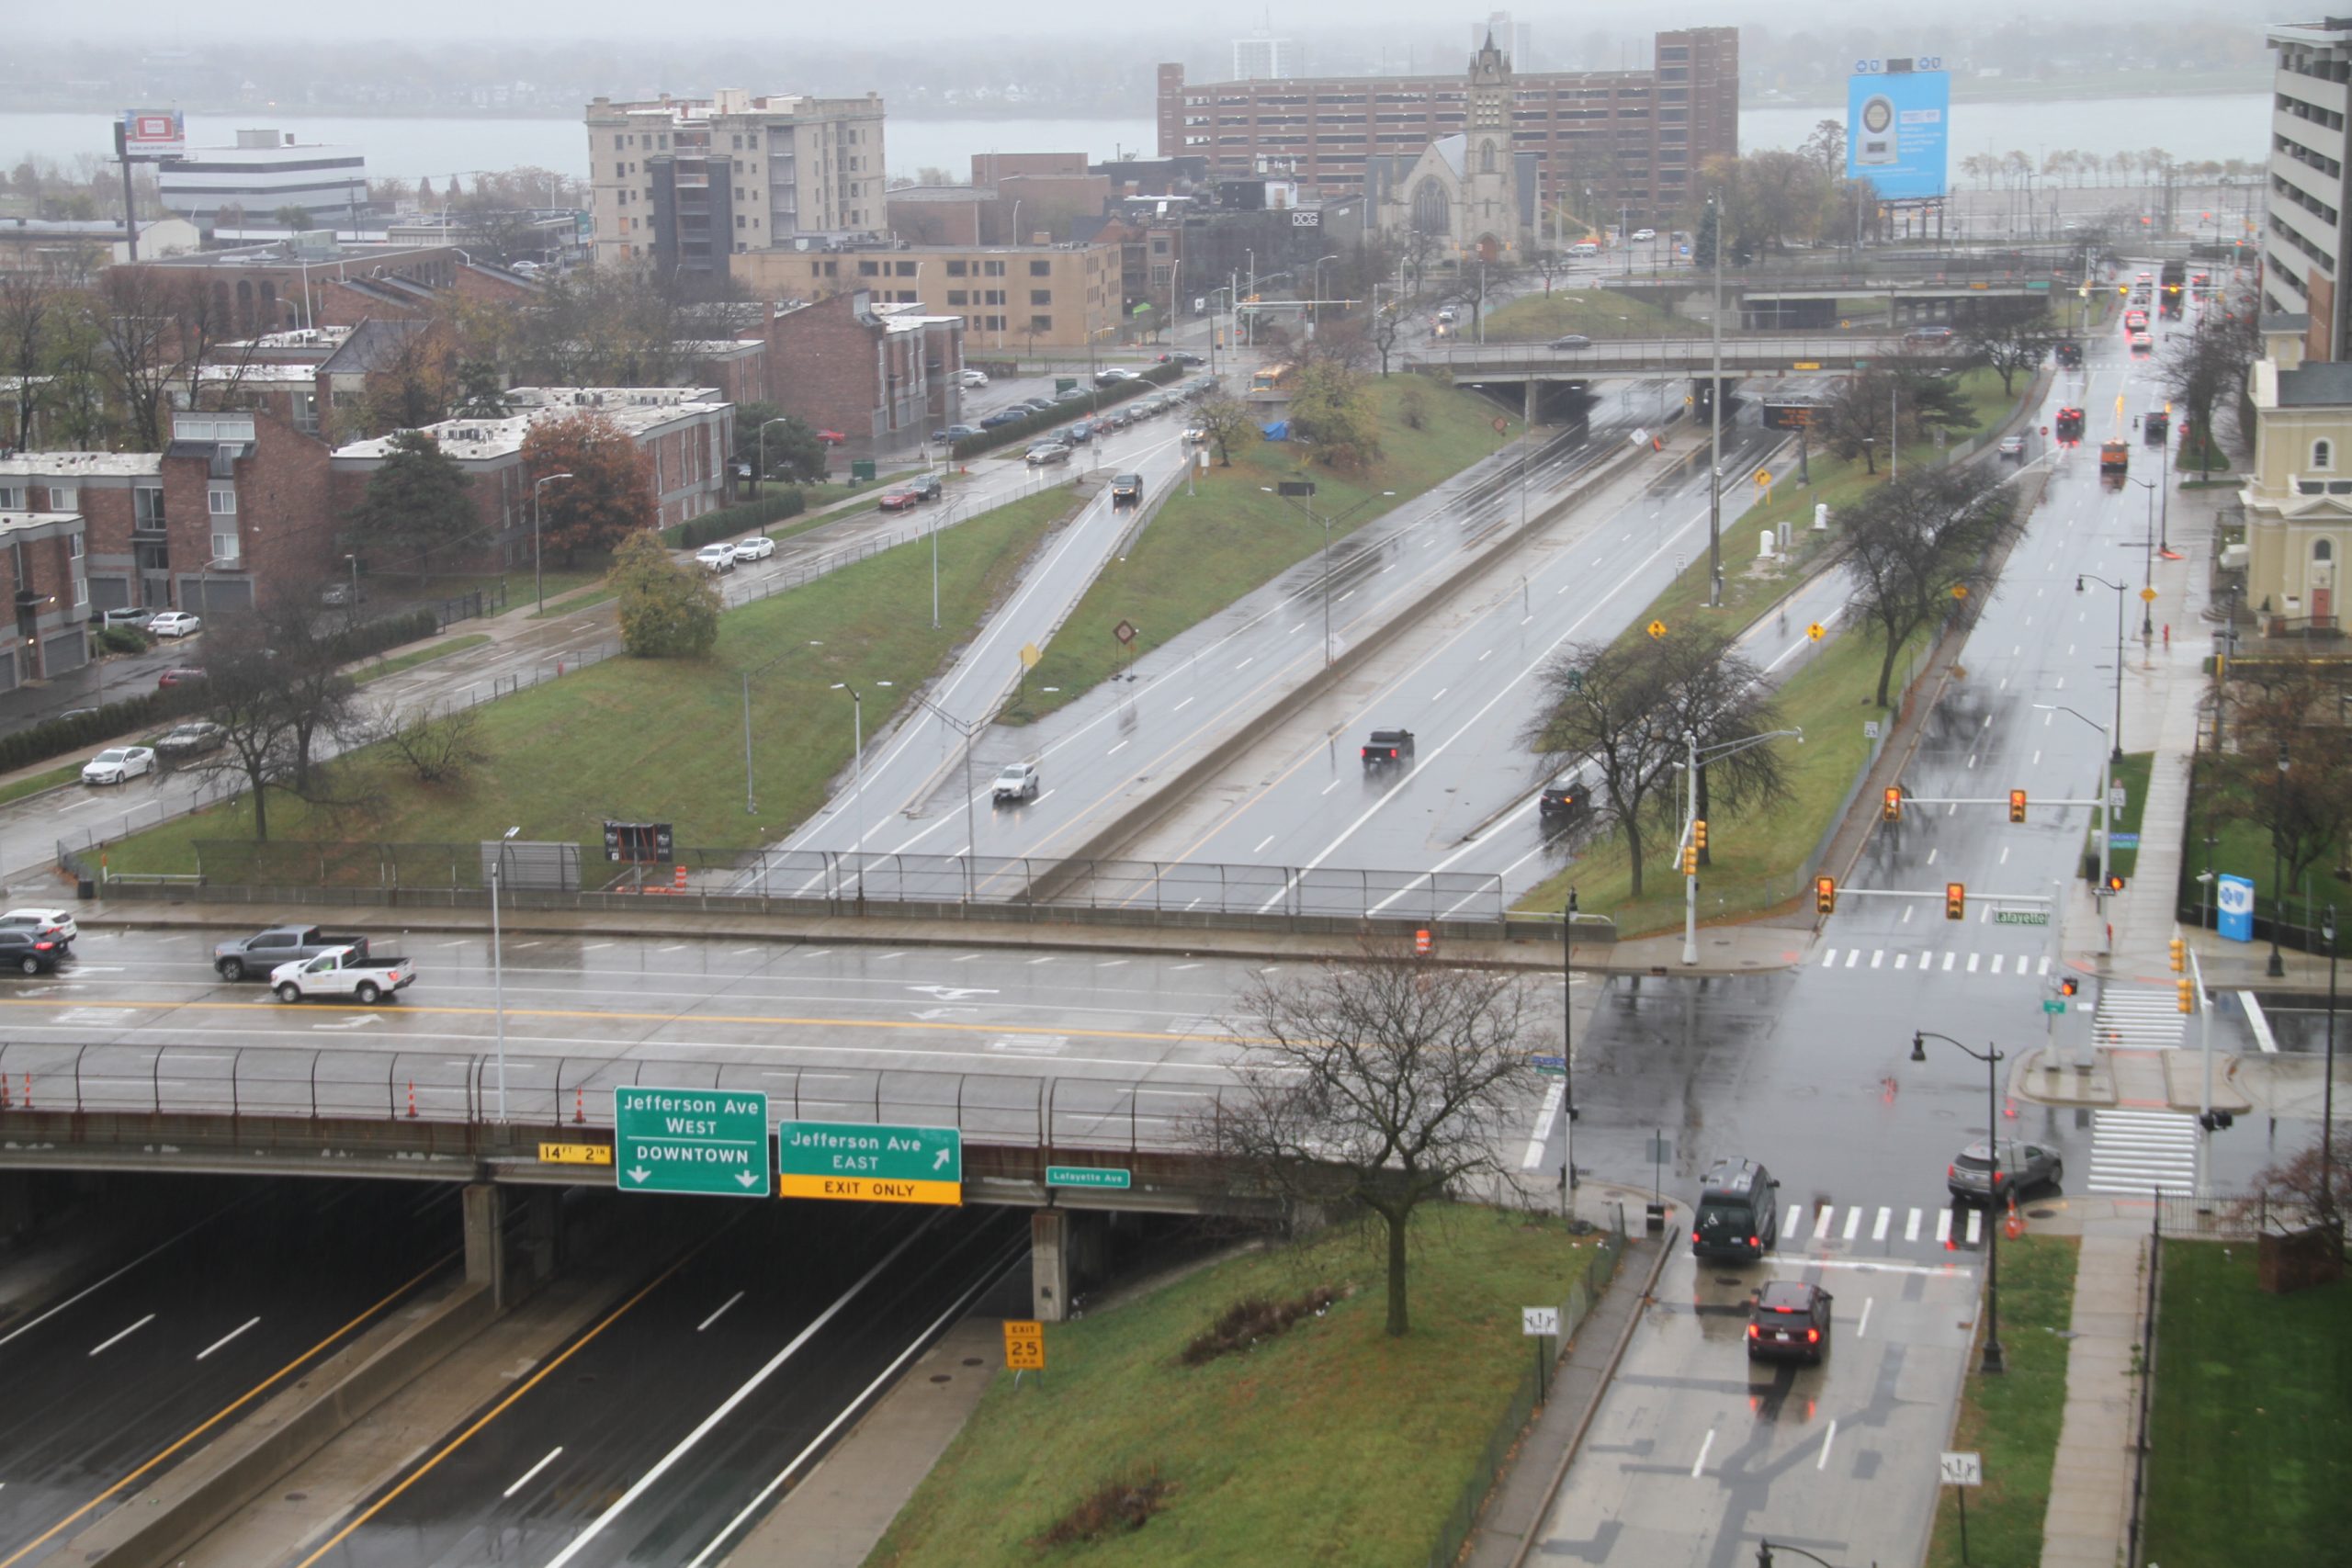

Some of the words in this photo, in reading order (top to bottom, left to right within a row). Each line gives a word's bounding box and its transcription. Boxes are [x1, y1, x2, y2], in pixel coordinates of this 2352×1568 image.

[1995, 911, 2044, 925] Lafayette
[624, 1095, 716, 1113] Jefferson
[724, 1100, 759, 1114] Ave
[665, 1117, 718, 1135] WEST
[790, 1132, 879, 1150] Jefferson
[887, 1136, 922, 1151] Ave
[637, 1145, 749, 1164] DOWNTOWN
[832, 1155, 879, 1170] EAST
[1053, 1171, 1102, 1183] Lafayette
[1104, 1174, 1123, 1183] Ave
[824, 1180, 861, 1195] EXIT
[873, 1182, 916, 1198] ONLY
[1012, 1325, 1035, 1334] EXIT
[1012, 1341, 1038, 1356] 25
